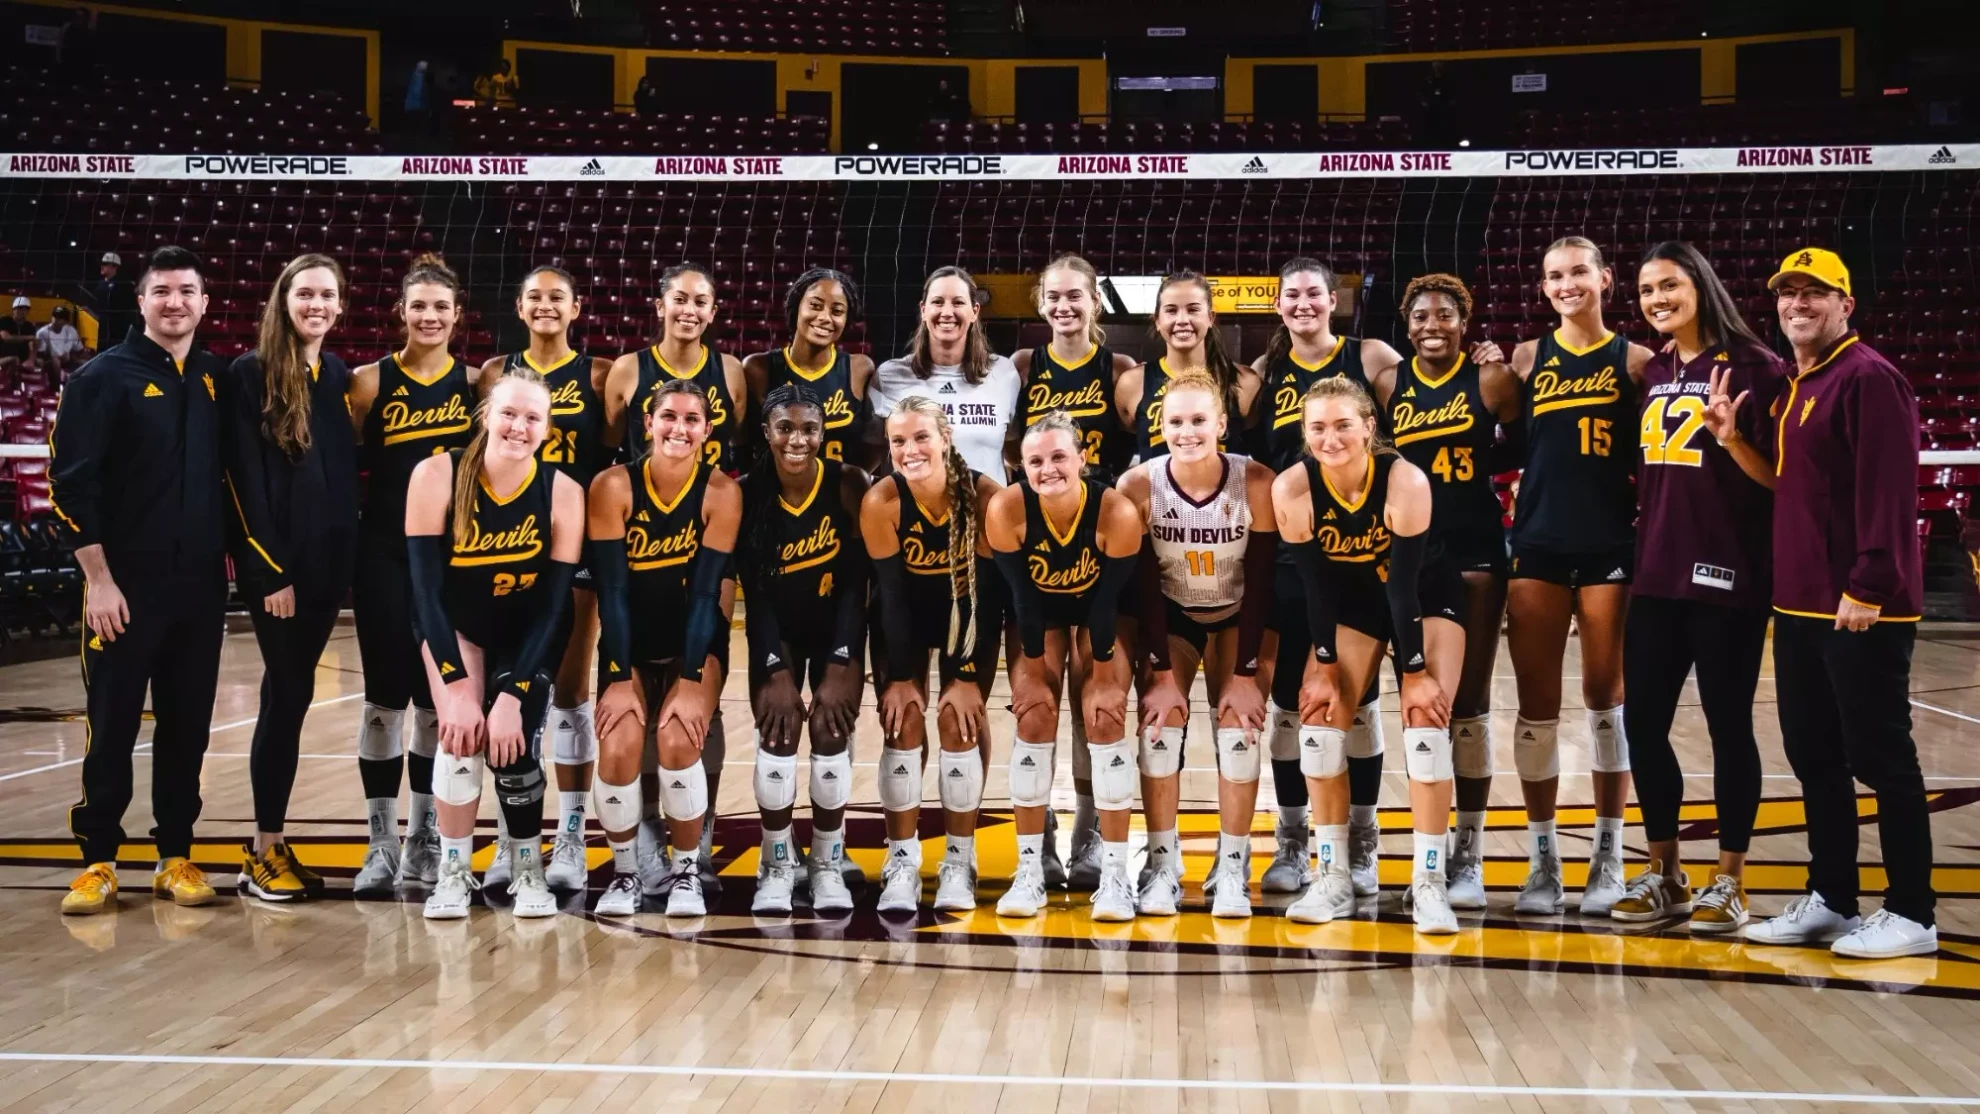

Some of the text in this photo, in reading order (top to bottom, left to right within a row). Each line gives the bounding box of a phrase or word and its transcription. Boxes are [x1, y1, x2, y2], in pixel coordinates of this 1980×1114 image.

[10, 156, 135, 172] ARIZONA STATE
[185, 157, 346, 174] POWERADE
[402, 158, 528, 174] ARIZONA STATE
[655, 158, 783, 174] ARIZONA STATE
[835, 157, 1001, 174] POWERADE
[1058, 156, 1188, 173] ARIZONA STATE
[1319, 153, 1451, 171] ARIZONA STATE
[1505, 151, 1678, 170] POWERADE
[1737, 147, 1873, 166] ARIZONA STATE
[1228, 287, 1241, 297] of
[1246, 287, 1275, 297] YOU
[1534, 366, 1618, 401] Devils
[1683, 382, 1711, 394] STATE
[1027, 379, 1104, 413] Devils
[383, 394, 470, 432] Devils
[959, 404, 996, 416] STATE
[1393, 392, 1468, 433] Devils
[960, 417, 996, 426] ALUMNI
[1578, 417, 1612, 456] 15
[1640, 396, 1707, 467] 42
[542, 428, 577, 464] 21
[1432, 447, 1474, 483] 43
[781, 516, 837, 560] evils
[1153, 524, 1245, 544] SUN DEVILS
[1028, 548, 1099, 585] Devils
[1185, 551, 1215, 576] 11
